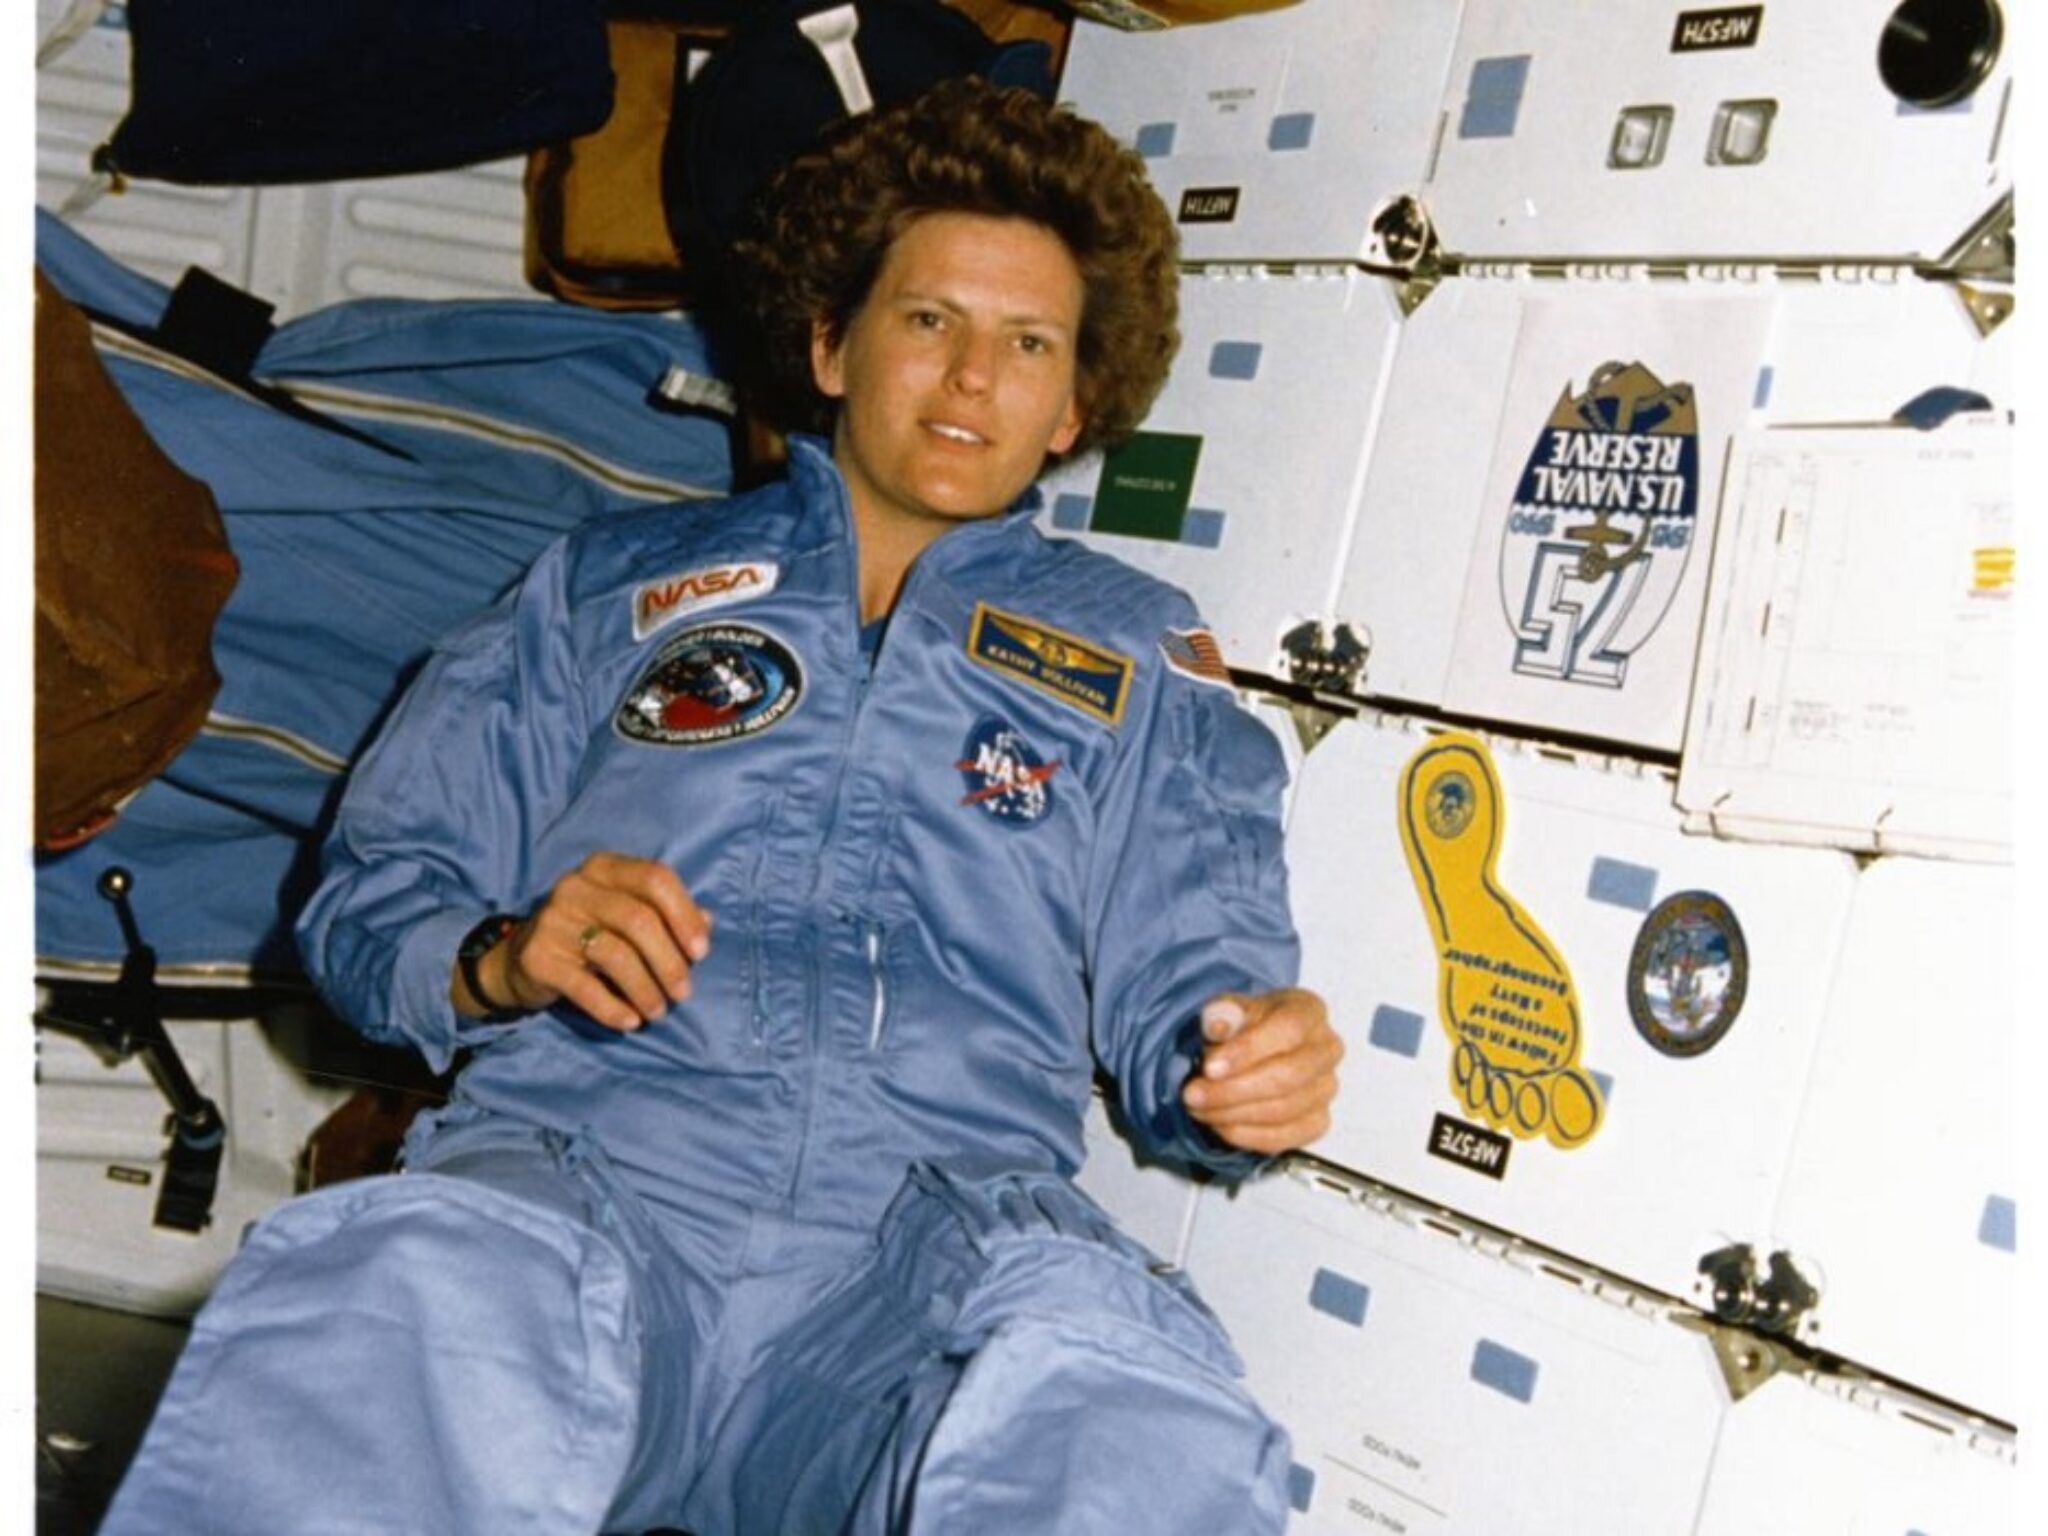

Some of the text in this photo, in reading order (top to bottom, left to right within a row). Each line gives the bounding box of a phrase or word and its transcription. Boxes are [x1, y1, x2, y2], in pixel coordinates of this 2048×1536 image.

[1681, 16, 1754, 45] MF57H
[1549, 430, 1683, 472] RESERVE
[1533, 466, 1634, 509] NAVAL
[643, 567, 761, 618] NASA
[1511, 540, 1654, 690] 75
[986, 644, 1108, 706] KATHY SULLIVAN
[974, 742, 1047, 802] NASA
[1489, 982, 1532, 1009] Navy
[1459, 1021, 1558, 1067] Follow in the
[1491, 1009, 1568, 1045] footsteps
[1439, 1124, 1504, 1169] MF57E
